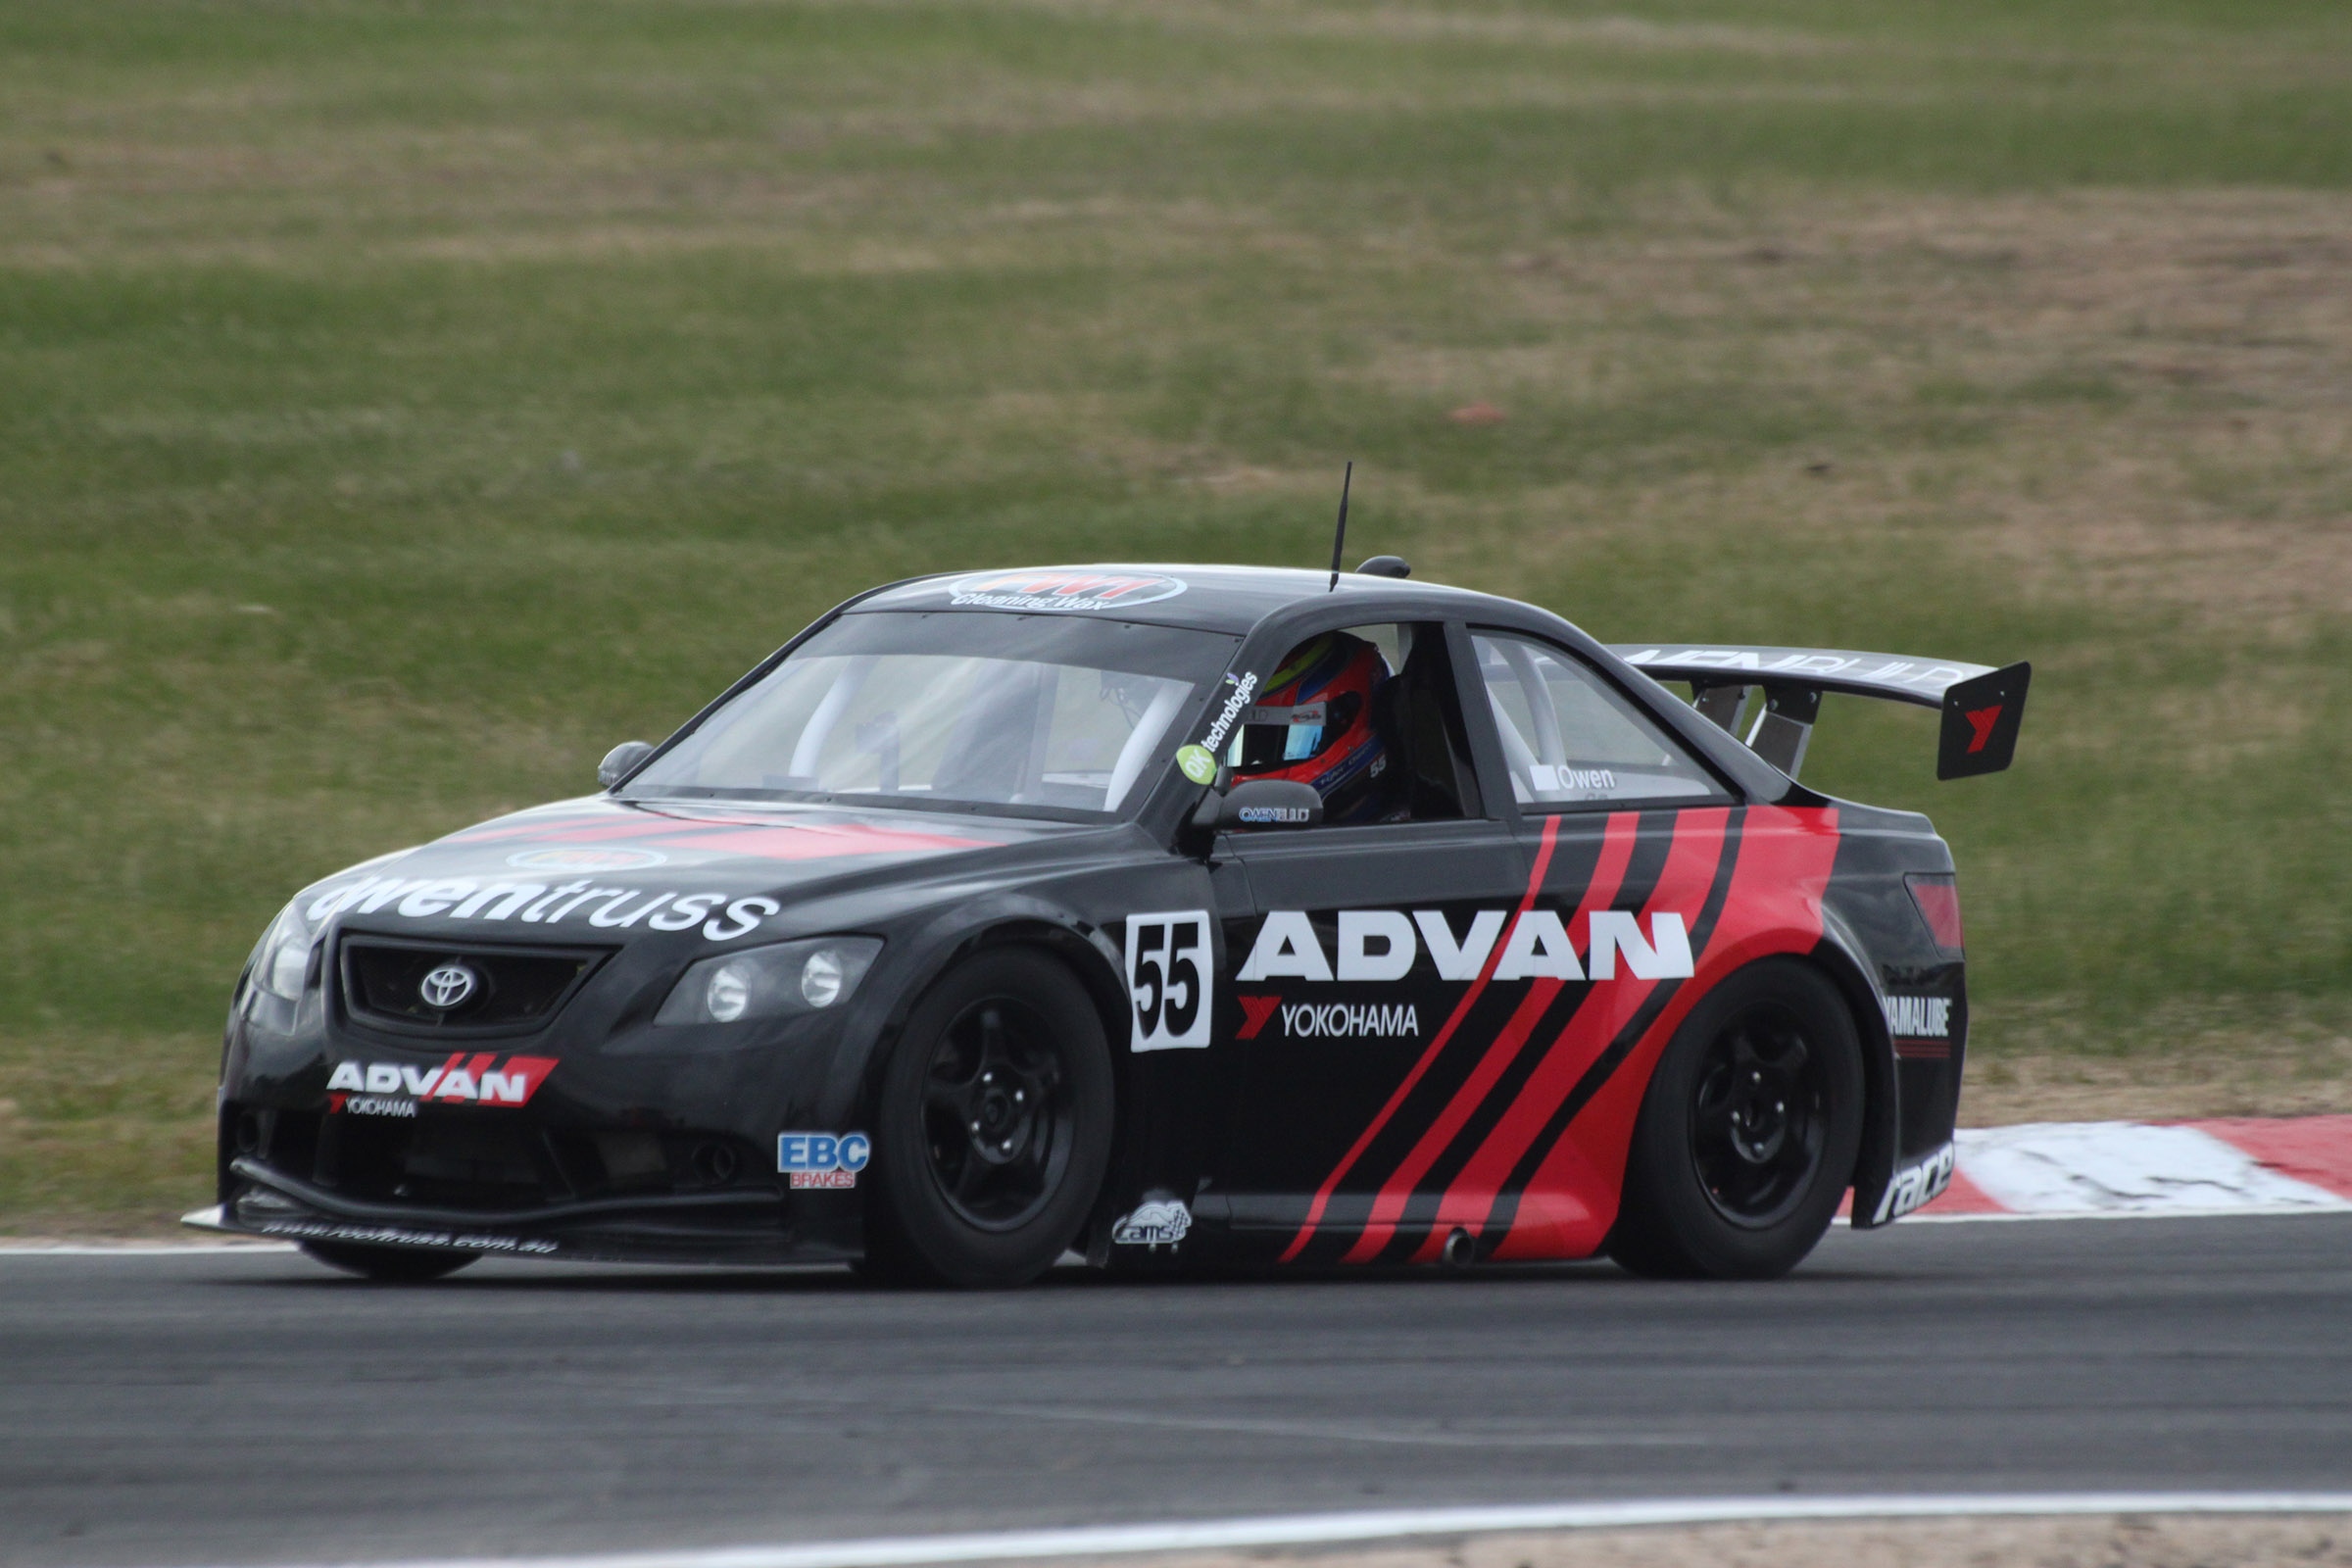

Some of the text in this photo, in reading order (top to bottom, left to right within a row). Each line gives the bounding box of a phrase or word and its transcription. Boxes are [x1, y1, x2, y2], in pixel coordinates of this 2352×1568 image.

[951, 594, 1110, 611] Cleaning Wax
[1200, 671, 1257, 753] technologies
[1557, 764, 1615, 789] Owen
[1235, 909, 1695, 982] ADVAN
[1133, 921, 1201, 1040] 55
[1281, 1003, 1419, 1039] YOKOHAMA
[326, 1060, 526, 1102] ADVAN
[344, 1097, 416, 1119] YOKOHAMA
[778, 1133, 870, 1173] EBC
[790, 1170, 856, 1189] BRAKES
[1873, 1141, 1955, 1225] race
